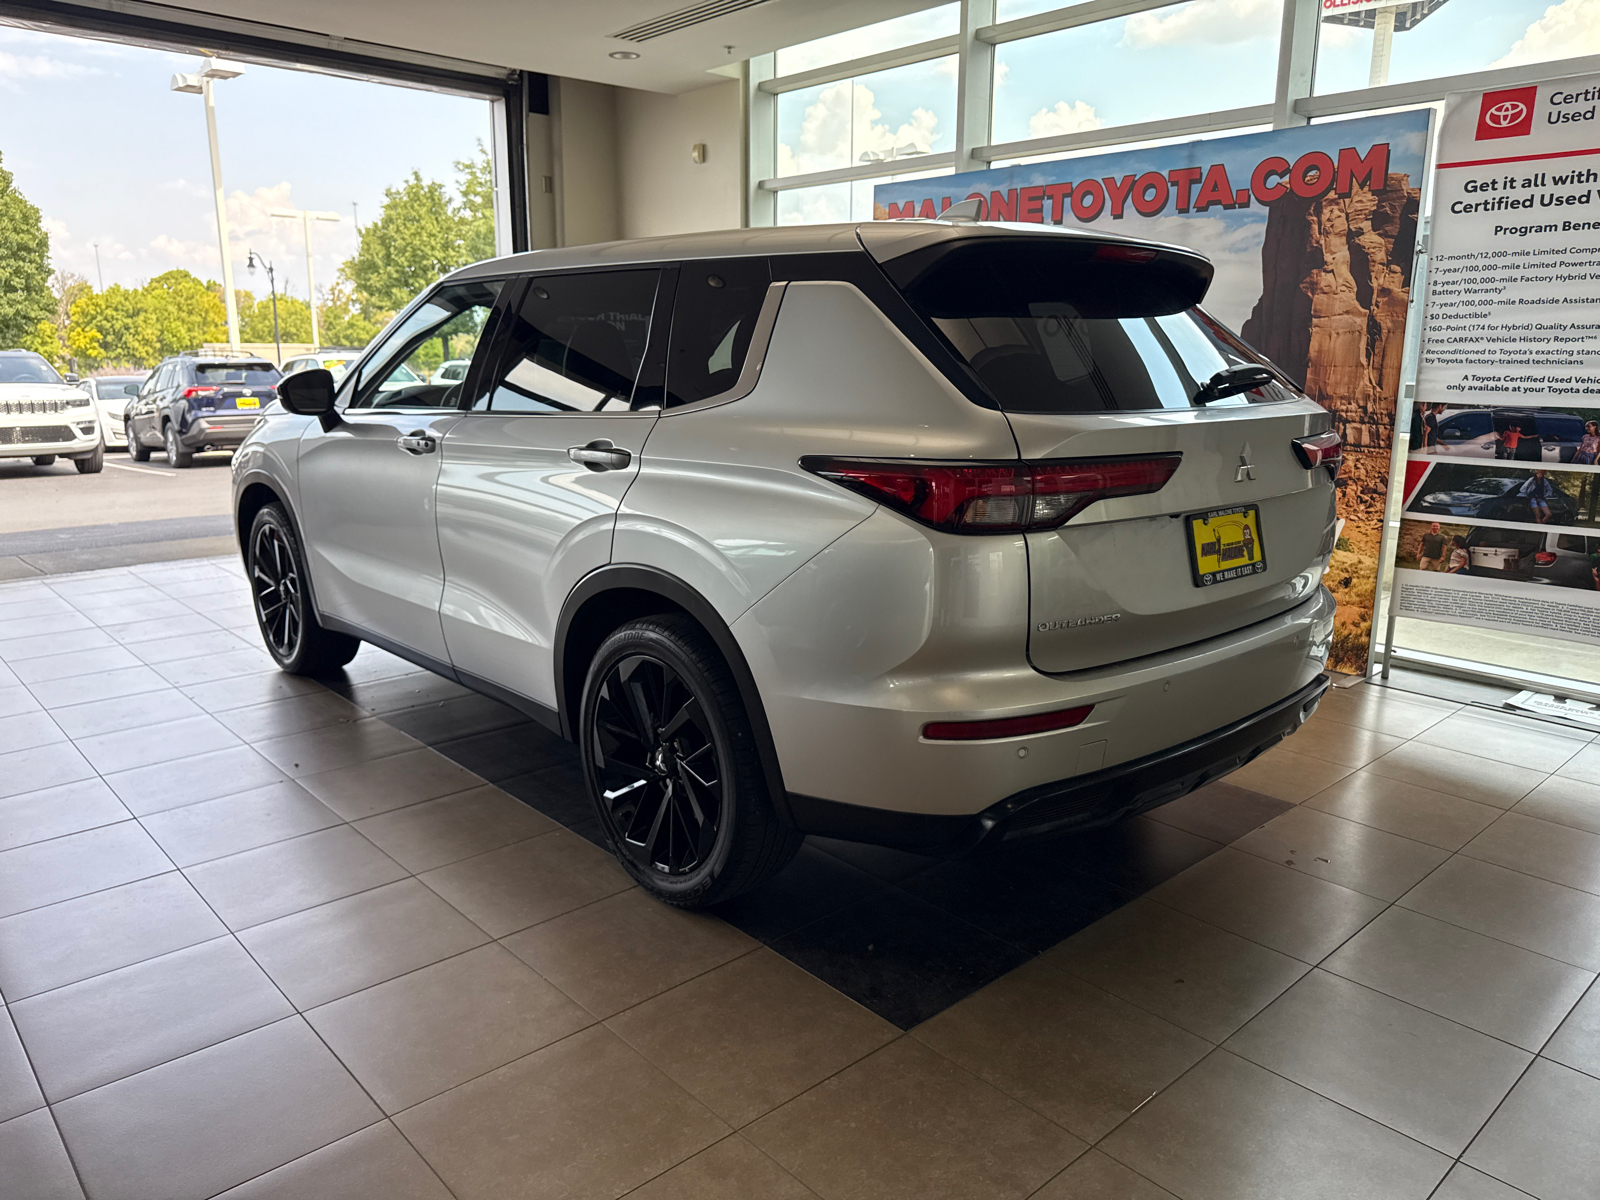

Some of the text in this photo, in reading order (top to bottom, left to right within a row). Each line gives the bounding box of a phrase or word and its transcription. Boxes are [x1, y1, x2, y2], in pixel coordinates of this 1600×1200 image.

[1547, 105, 1596, 125] Used
[1463, 168, 1598, 194] Get it all with
[1450, 193, 1535, 214] Certified
[1539, 189, 1592, 207] Used
[1494, 222, 1558, 237] Program
[1435, 250, 1531, 262] 12-month/12,000-mile
[1532, 247, 1567, 257] Limited
[1433, 263, 1521, 275] 7-year/100,000-mile
[1522, 261, 1557, 270] Limited
[1432, 275, 1519, 287] 8-year/100,000-mile
[1520, 274, 1553, 284] Factory
[1555, 273, 1588, 283] Hybrid
[1431, 288, 1462, 297] Battery
[1430, 299, 1517, 310] 7-year/100,000-mile
[1518, 297, 1560, 306] Roadside
[1428, 324, 1467, 332] 160-Point
[1468, 324, 1486, 332] (174
[1500, 323, 1533, 332] Hybrid)
[1534, 323, 1568, 332] Quality
[1519, 336, 1552, 344] History
[1425, 348, 1486, 356] Reconditioned
[1498, 348, 1533, 357] Toyota's
[1534, 348, 1575, 357] exacting
[1425, 357, 1435, 365] by
[1465, 357, 1530, 366] factory-trained
[1532, 358, 1584, 366] technicians
[1470, 375, 1502, 384] Toyota
[1503, 375, 1546, 384] Certified
[1547, 375, 1574, 384] Used
[1446, 383, 1466, 392] only
[1467, 384, 1510, 392] available
[1547, 386, 1581, 395] Toyota
[1582, 386, 1600, 395] dea
[1215, 565, 1253, 581] WE MAKE IT EASY
[1037, 613, 1121, 632] OUTLANDER
